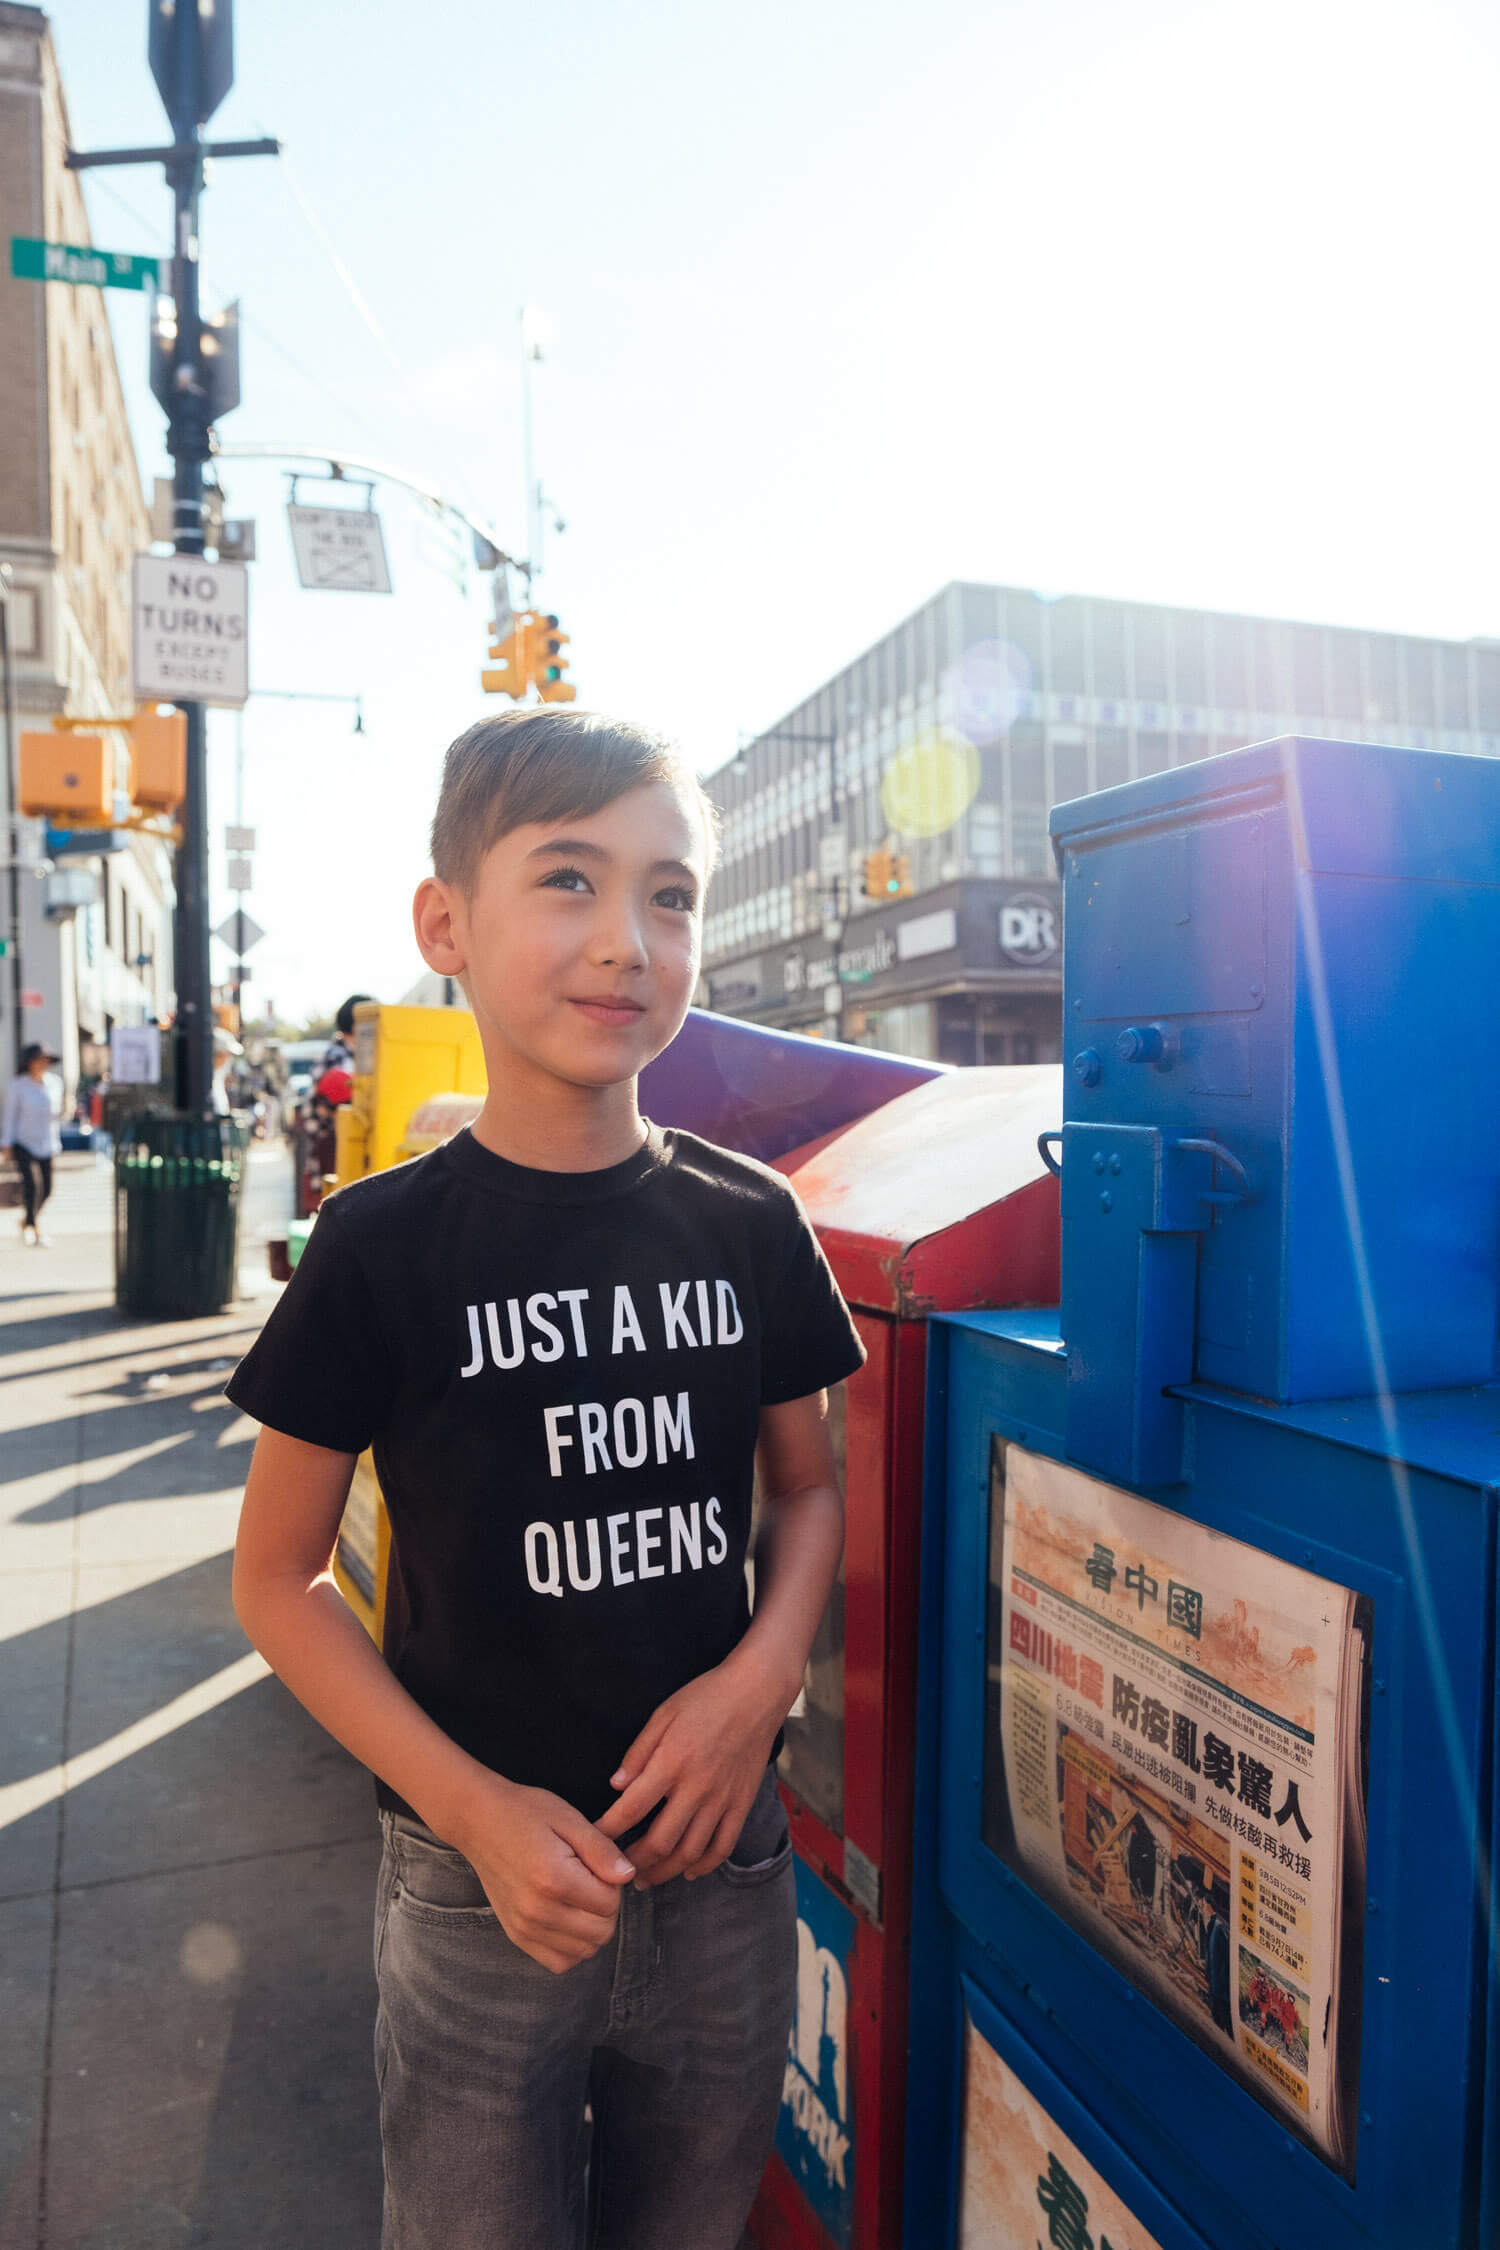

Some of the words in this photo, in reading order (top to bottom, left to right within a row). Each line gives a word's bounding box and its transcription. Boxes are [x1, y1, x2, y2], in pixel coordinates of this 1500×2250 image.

[143, 604, 242, 642] TURNS
[168, 573, 218, 602] NO
[1001, 905, 1056, 951] DR
[461, 1288, 590, 1378] JUST
[611, 1285, 647, 1354] A
[659, 1279, 744, 1350] KID
[543, 1392, 695, 1477] FROM
[524, 1497, 728, 1598] QUEENS
[1155, 1629, 1201, 1662] TIMES
[1010, 1609, 1104, 1710] 四川地震
[1112, 1673, 1313, 1843] 防疫亂象驚人
[1204, 1796, 1313, 1882] 先做核酸再救援
